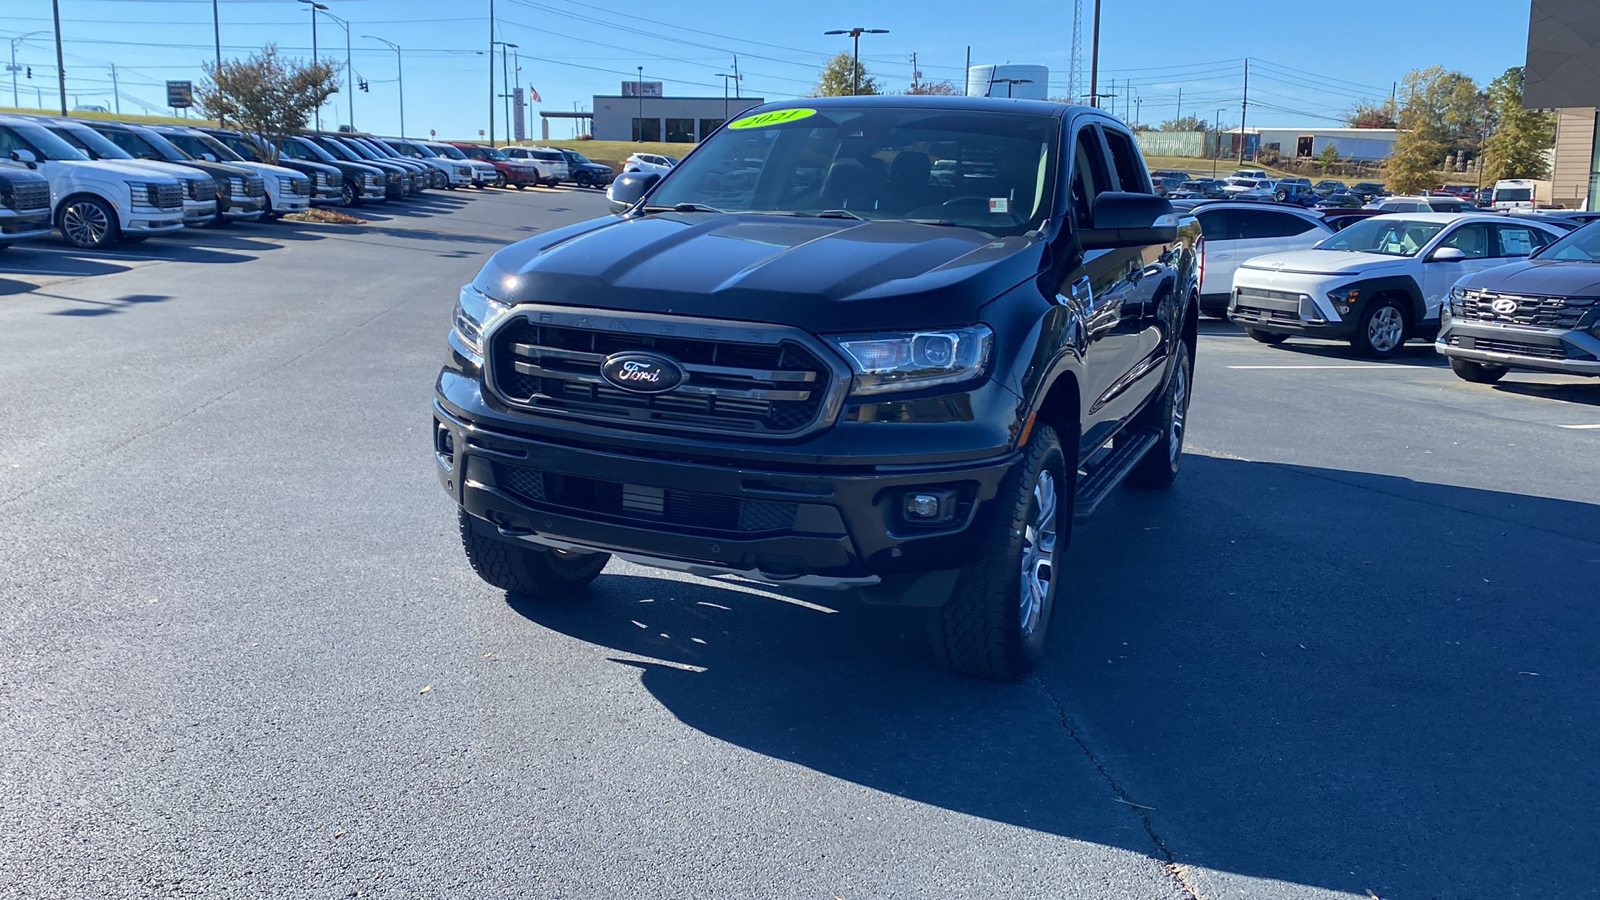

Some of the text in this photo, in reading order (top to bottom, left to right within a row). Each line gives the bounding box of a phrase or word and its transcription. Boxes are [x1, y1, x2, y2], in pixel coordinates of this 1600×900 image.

[738, 109, 800, 127] 2021
[538, 312, 765, 342] RANGER
[619, 361, 660, 384] Ford
